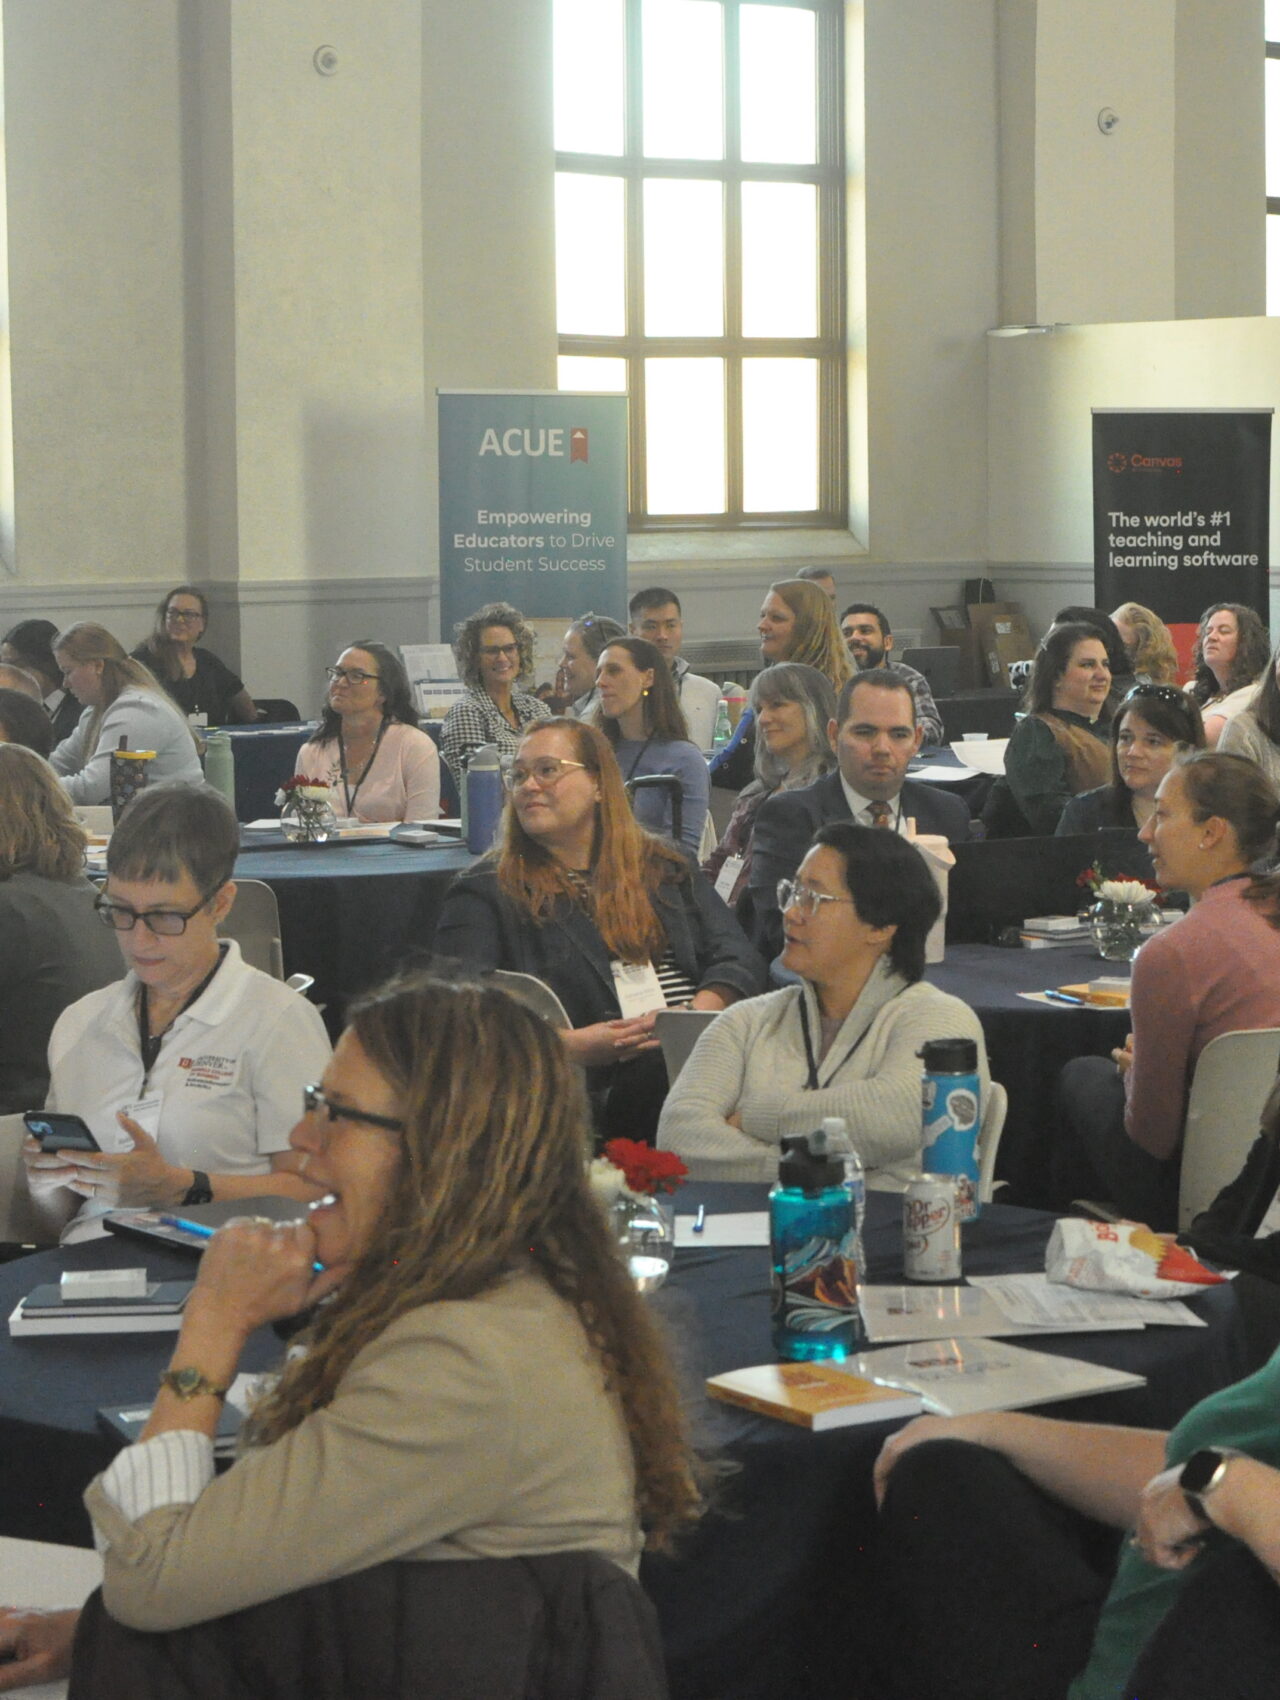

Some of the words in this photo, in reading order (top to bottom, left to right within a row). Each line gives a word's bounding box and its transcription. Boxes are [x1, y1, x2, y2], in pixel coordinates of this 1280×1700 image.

[478, 427, 564, 457] ACUE
[1131, 454, 1183, 468] Canvas
[477, 509, 592, 527] Empowering
[1108, 511, 1140, 527] The
[1144, 511, 1206, 527] world’s
[1209, 511, 1231, 527] #1
[454, 533, 545, 548] Educators
[550, 534, 567, 548] to
[571, 532, 616, 548] Drive
[1108, 531, 1183, 550] teaching
[1188, 531, 1221, 547] and
[464, 556, 534, 573] Student
[538, 556, 606, 572] Success
[1108, 551, 1179, 570] learning
[1182, 551, 1259, 567] software
